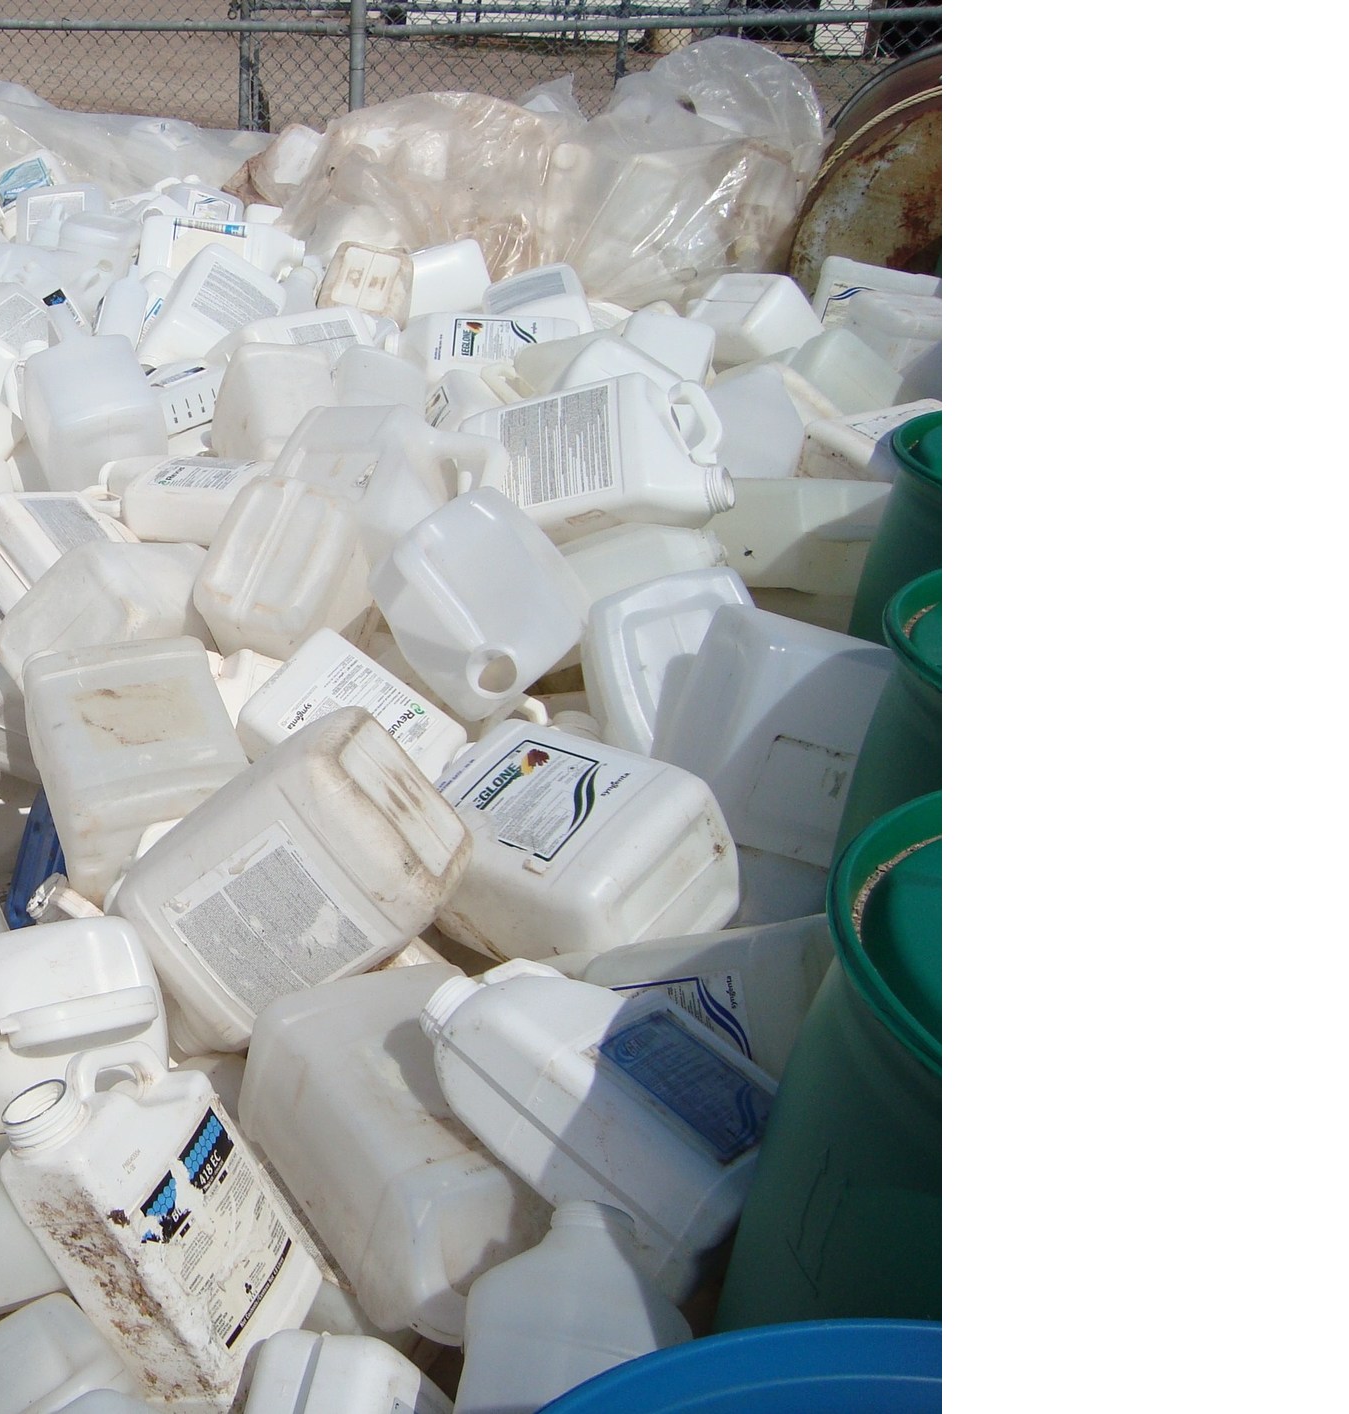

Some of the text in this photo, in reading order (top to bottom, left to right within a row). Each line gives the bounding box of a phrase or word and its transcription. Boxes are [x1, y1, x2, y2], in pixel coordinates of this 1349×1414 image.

[461, 329, 471, 356] EGLONE
[286, 702, 313, 731] syngenta
[471, 762, 520, 809] EGLONE
[600, 772, 631, 797] syngenta
[726, 975, 738, 1010] syngenta
[199, 1161, 216, 1186] 418
[210, 1149, 222, 1169] EC
